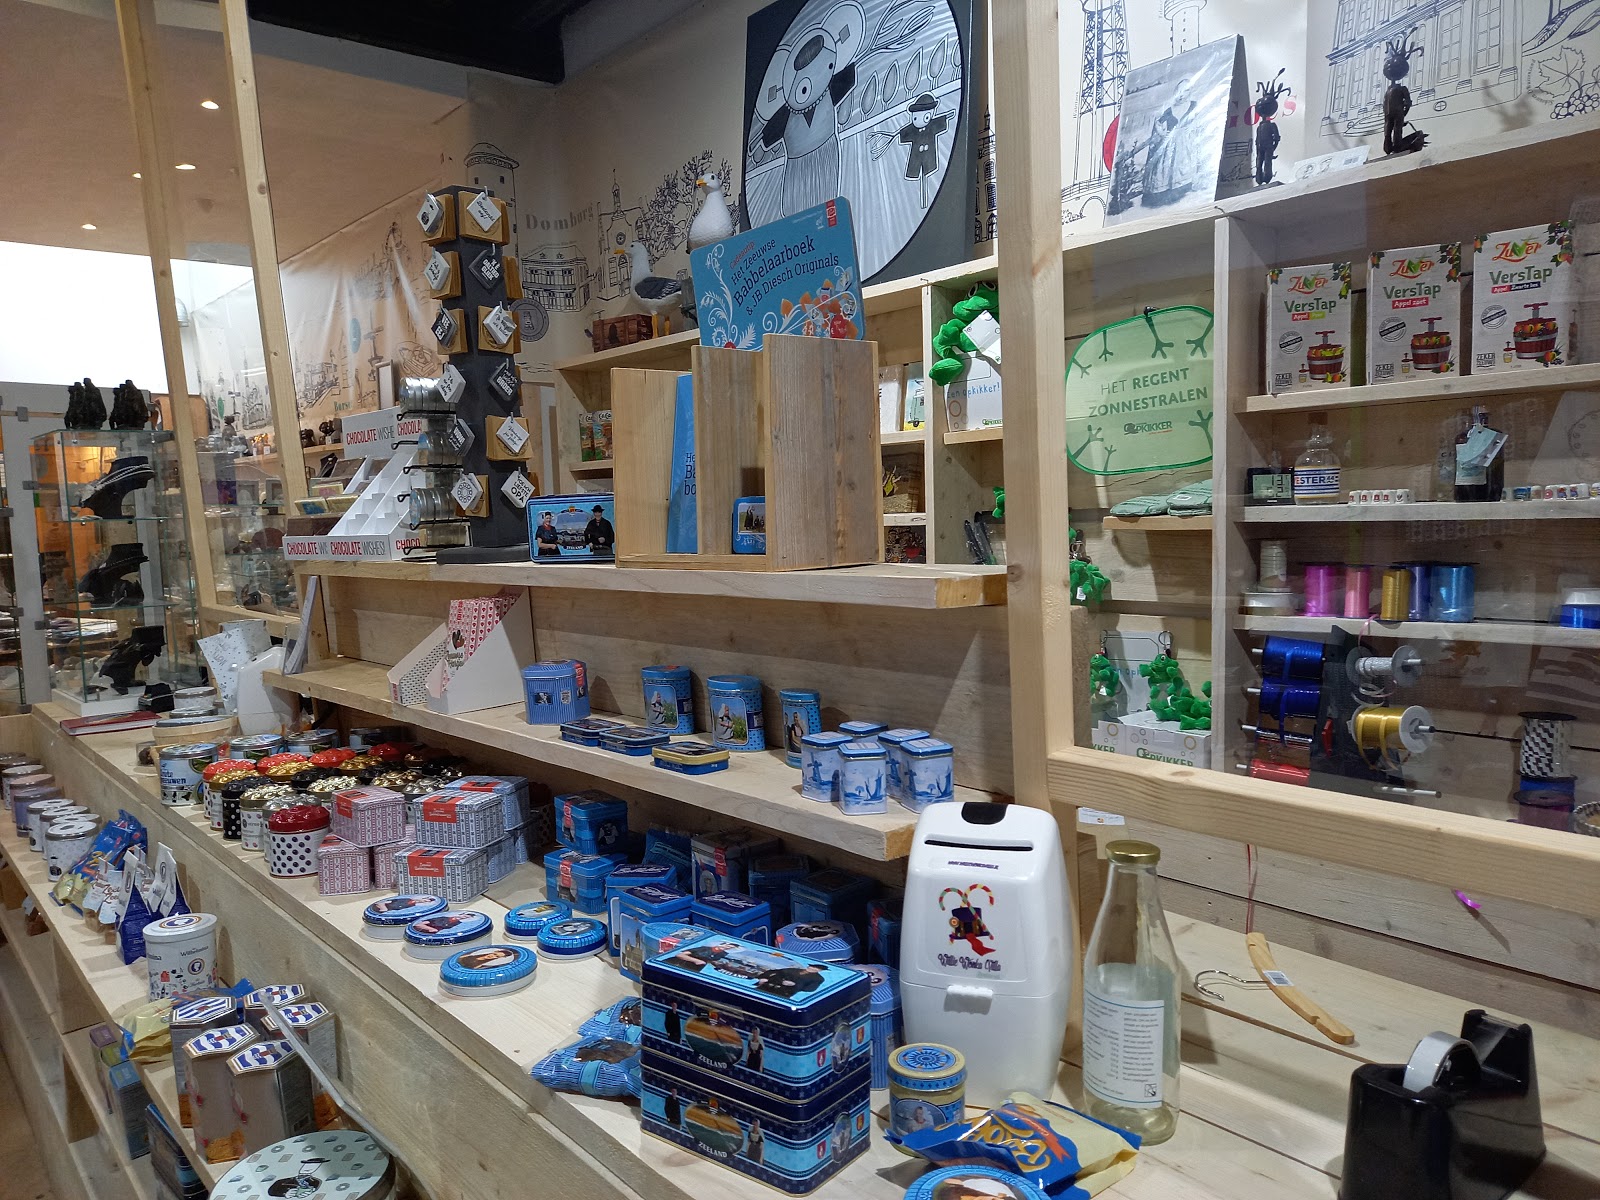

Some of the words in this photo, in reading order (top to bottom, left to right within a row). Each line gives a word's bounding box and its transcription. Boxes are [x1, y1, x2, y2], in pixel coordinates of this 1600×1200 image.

[524, 202, 594, 231] Domburg
[731, 269, 747, 286] Het
[743, 238, 777, 270] Zeeuwse
[733, 235, 817, 307] Babbelaarboek
[1489, 265, 1553, 284] VersTap
[746, 306, 754, 316] &
[752, 289, 764, 308] JB
[763, 269, 794, 296] Diesch
[795, 253, 840, 277] Originals
[1383, 281, 1442, 299] VersTap
[1284, 297, 1337, 313] VersTap
[1100, 379, 1128, 395] HET
[1132, 367, 1189, 390] REGENT
[962, 382, 1000, 398] opkikker!
[1088, 386, 1208, 418] ZONNESTRALEN
[346, 428, 377, 445] CHOCOLATE
[377, 425, 395, 441] WISHE
[397, 420, 422, 436] CHOCOLA
[685, 452, 696, 463] He
[511, 486, 525, 503] OPA
[684, 479, 697, 496] bo
[287, 541, 319, 555] CHOCOLATE
[330, 541, 362, 555] CHOCOLATE
[395, 537, 420, 551] CHOCO
[698, 1053, 728, 1070] ZEELAND
[698, 1140, 728, 1158] ZEELAND
